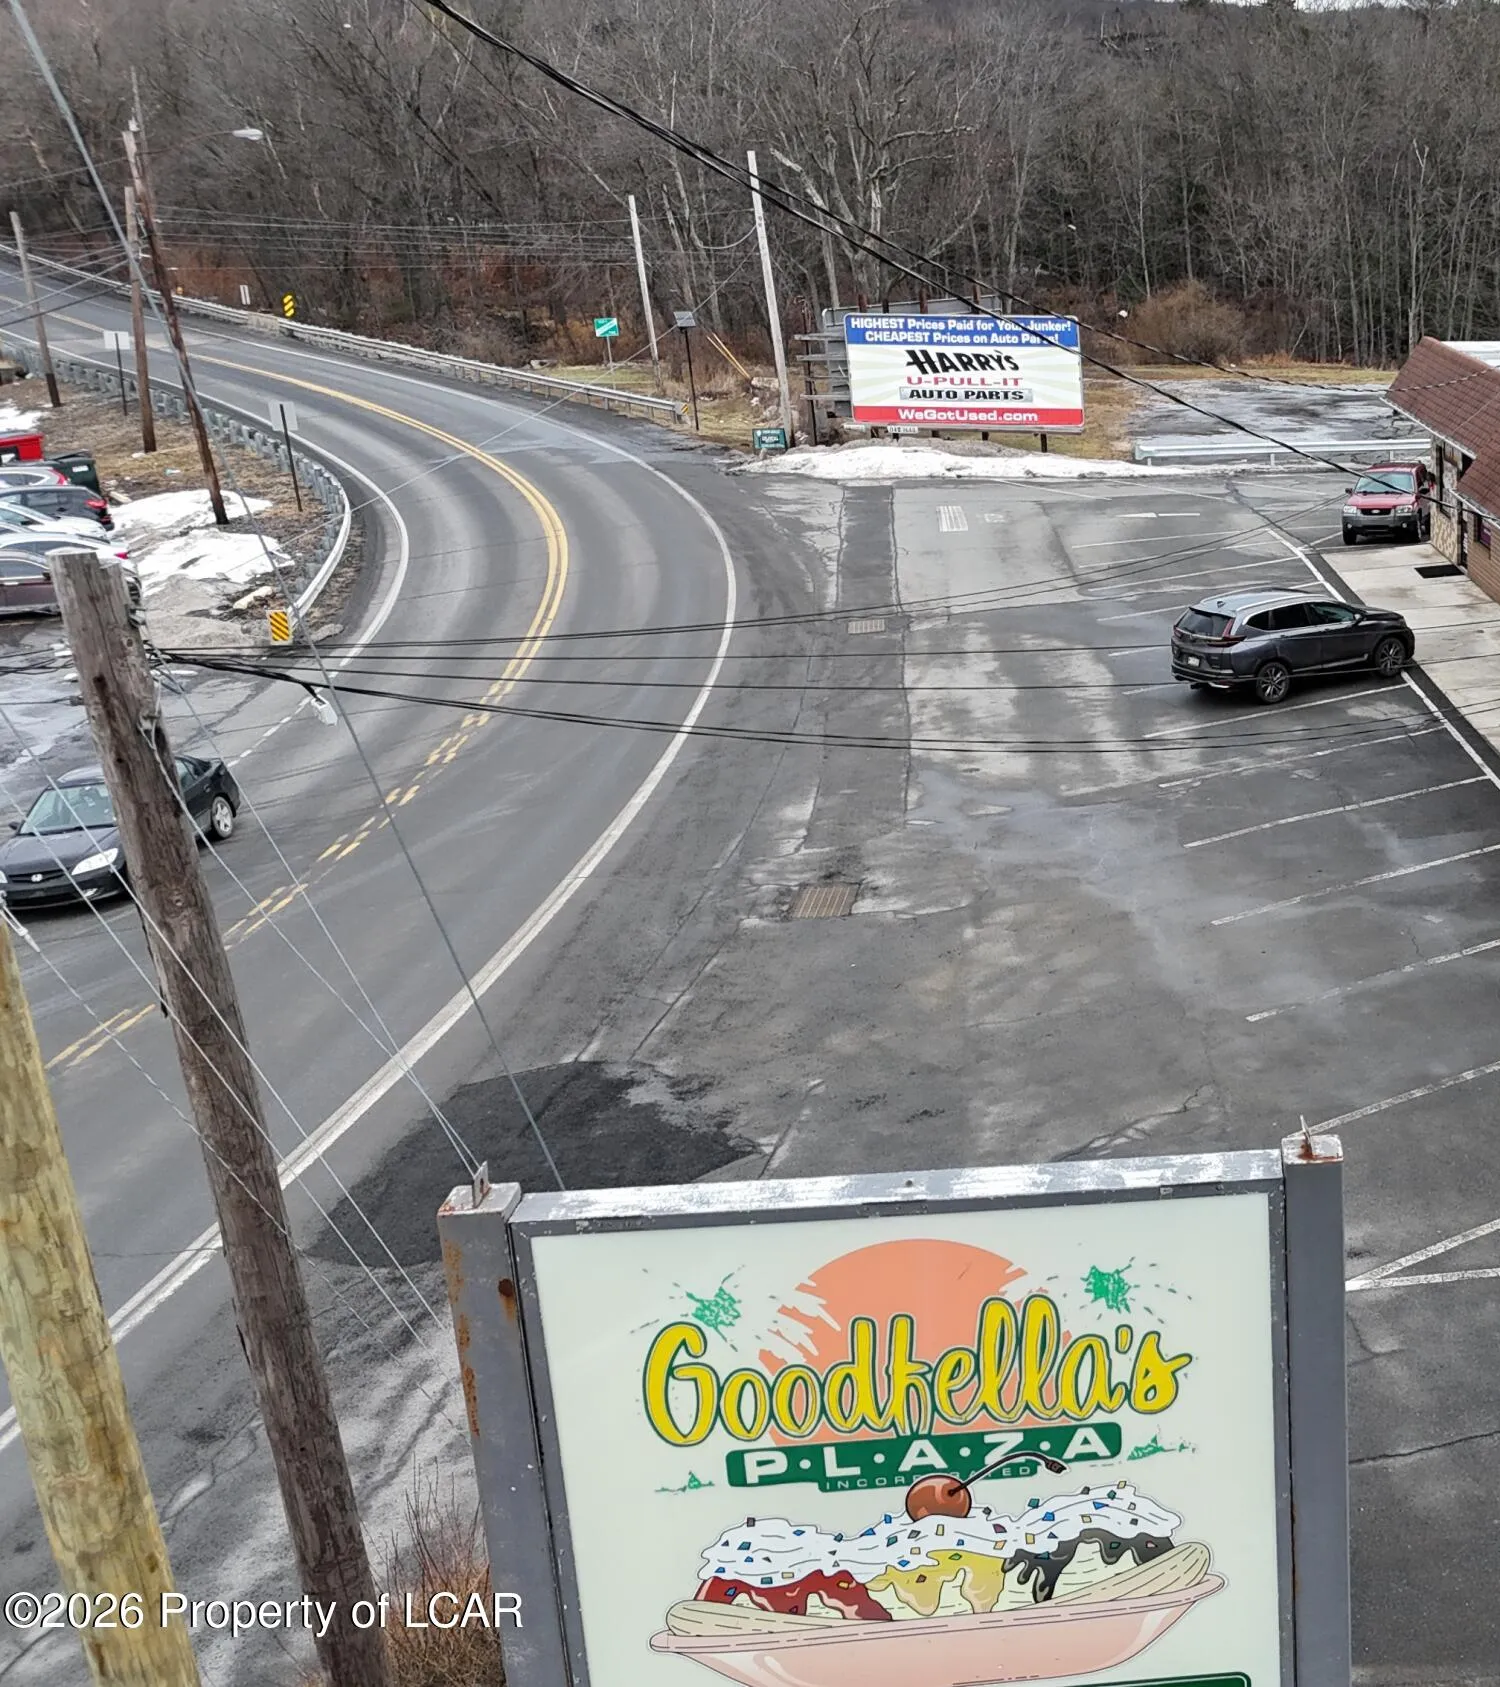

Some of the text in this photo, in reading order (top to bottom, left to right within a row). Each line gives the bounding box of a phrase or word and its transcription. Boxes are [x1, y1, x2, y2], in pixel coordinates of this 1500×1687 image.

[850, 317, 1072, 332] HIGHEST Prices Paid for Your Junker!
[865, 331, 930, 342] CHEAPEST
[933, 332, 970, 343] Prices
[973, 334, 987, 344] on
[990, 333, 1018, 344] Auto
[905, 349, 1020, 375] HARRY'S
[906, 376, 1023, 387] U-PULL-IT
[909, 388, 1024, 400] AUTO PARTS
[898, 408, 1039, 422] WeGotUsed.com
[643, 1294, 1193, 1447] Goodfella's
